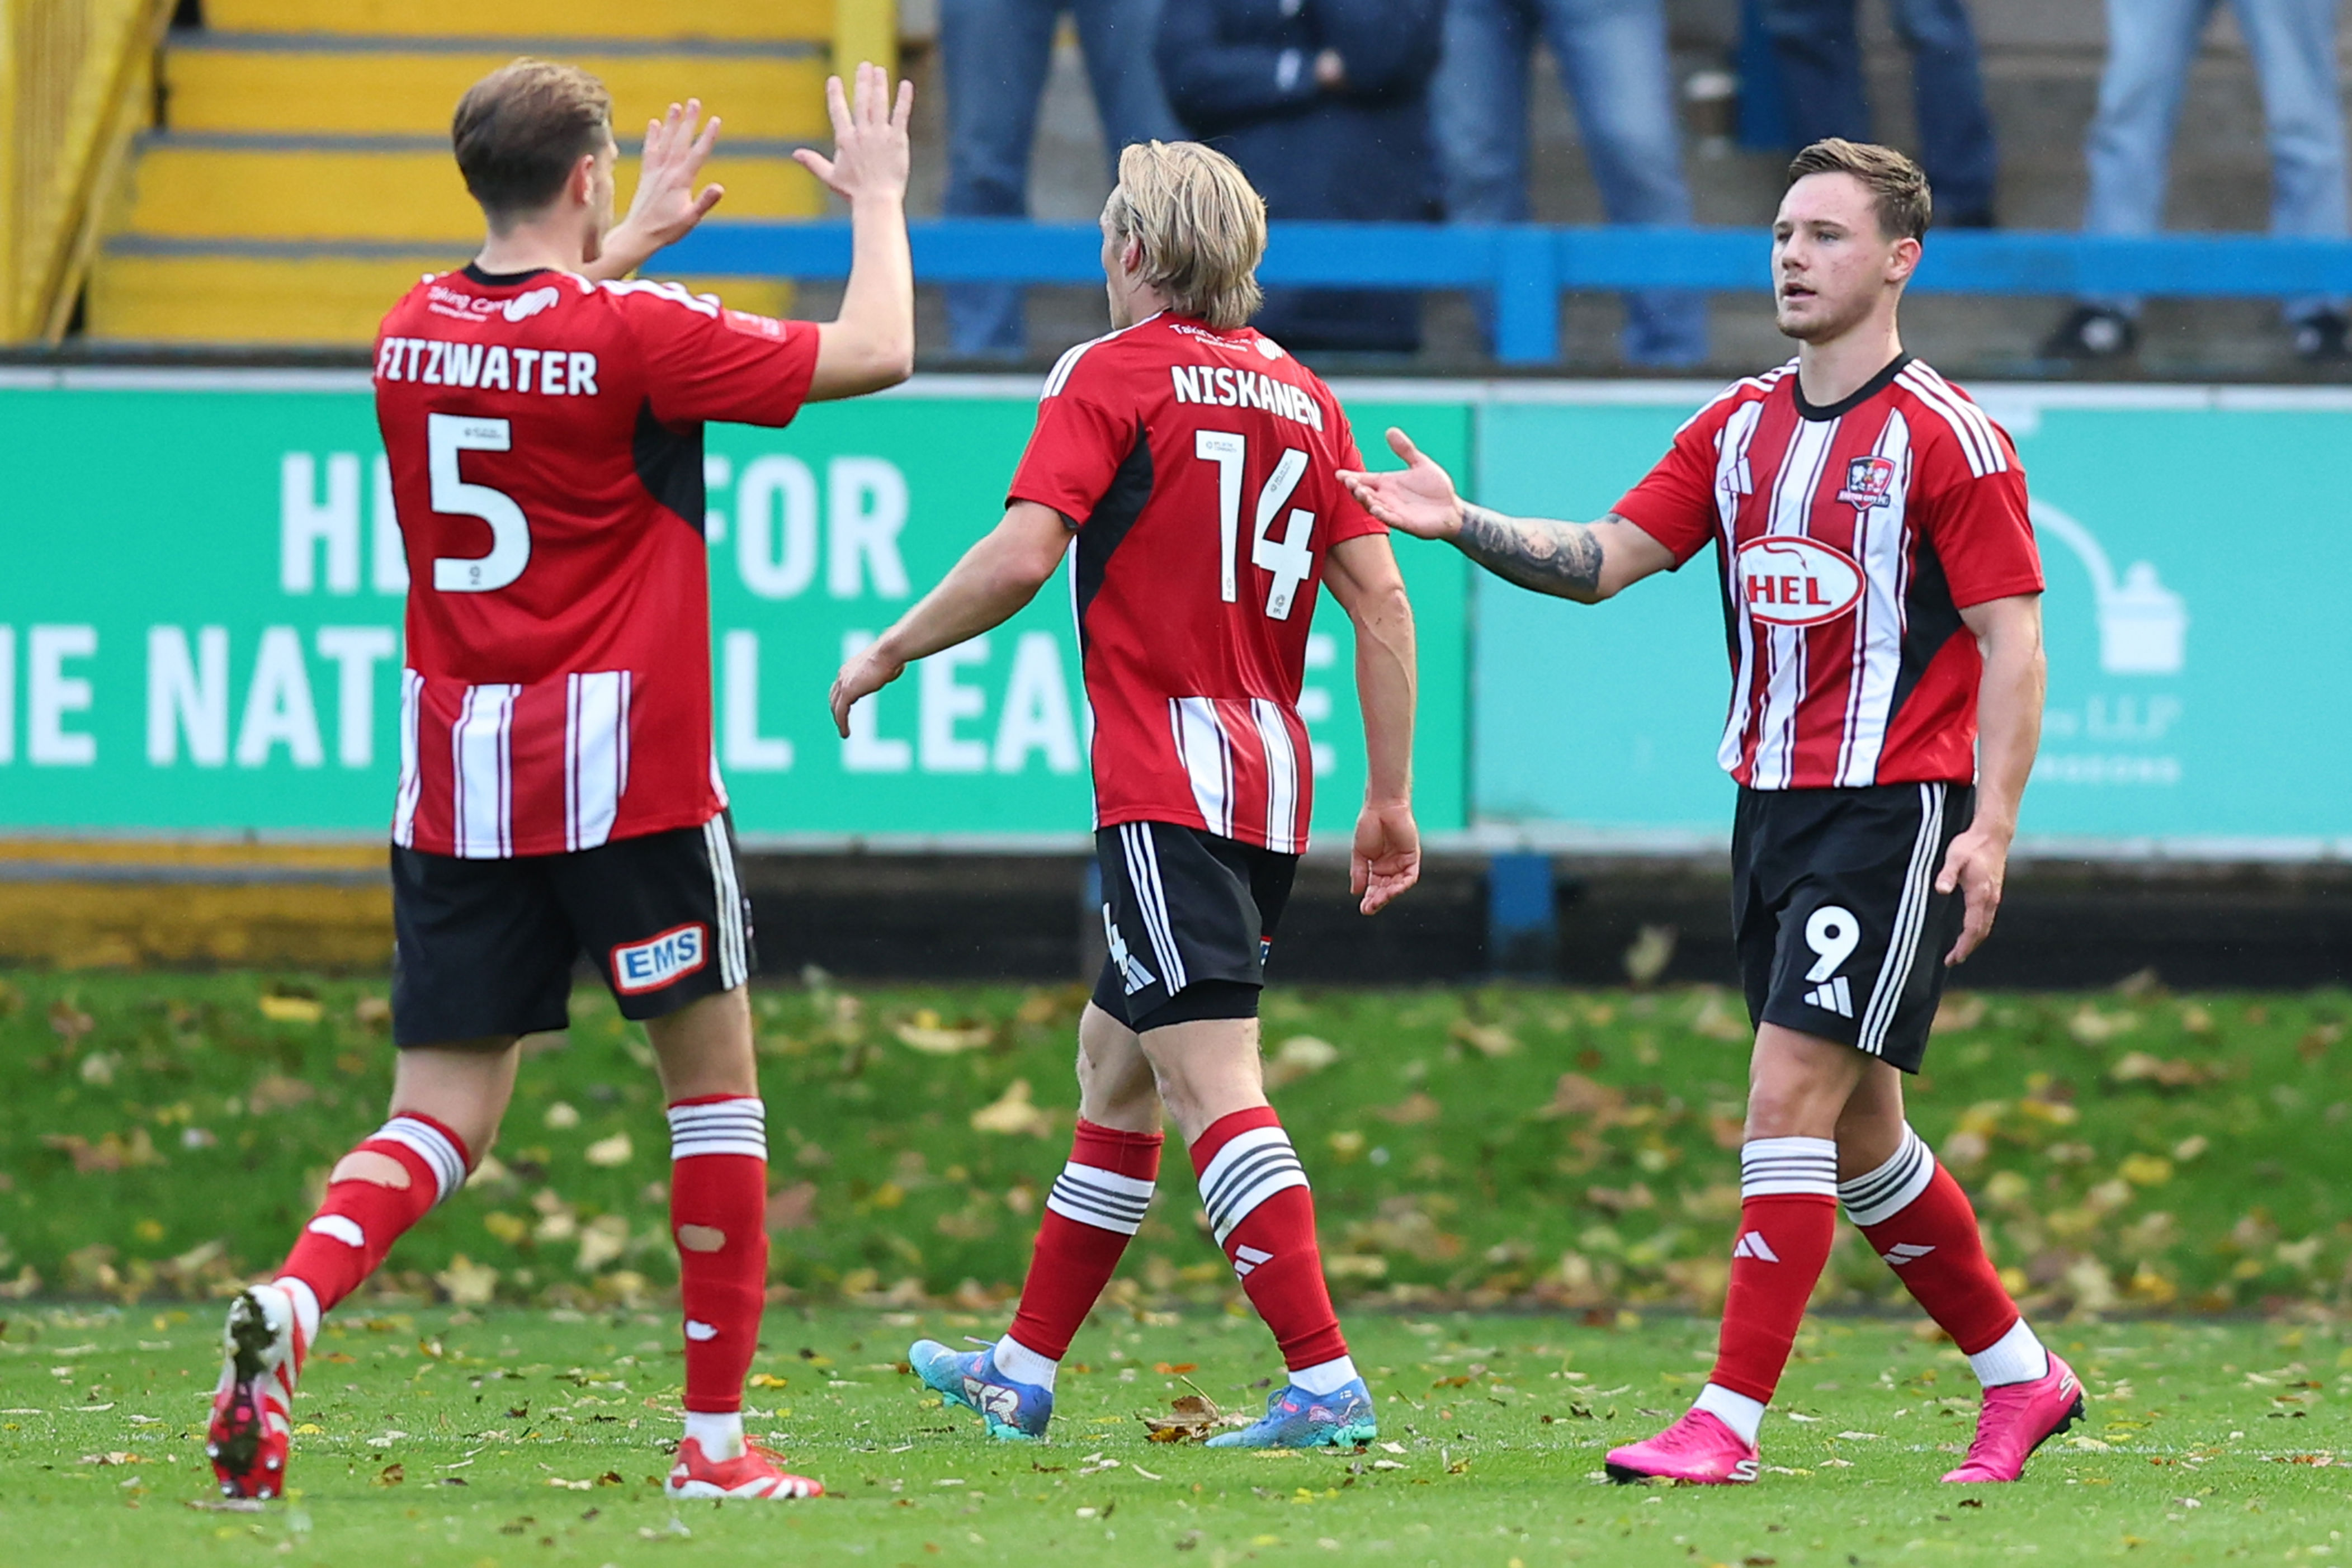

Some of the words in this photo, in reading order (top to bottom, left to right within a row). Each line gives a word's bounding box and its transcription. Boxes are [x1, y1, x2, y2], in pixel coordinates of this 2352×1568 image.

[376, 337, 598, 395] FITZWATER
[1171, 366, 1324, 432] NISKANEN
[427, 412, 531, 593] 5
[1196, 429, 1316, 621] 14
[1748, 575, 1831, 606] HEL
[625, 931, 697, 979] EMS
[1805, 905, 1860, 983] 9
